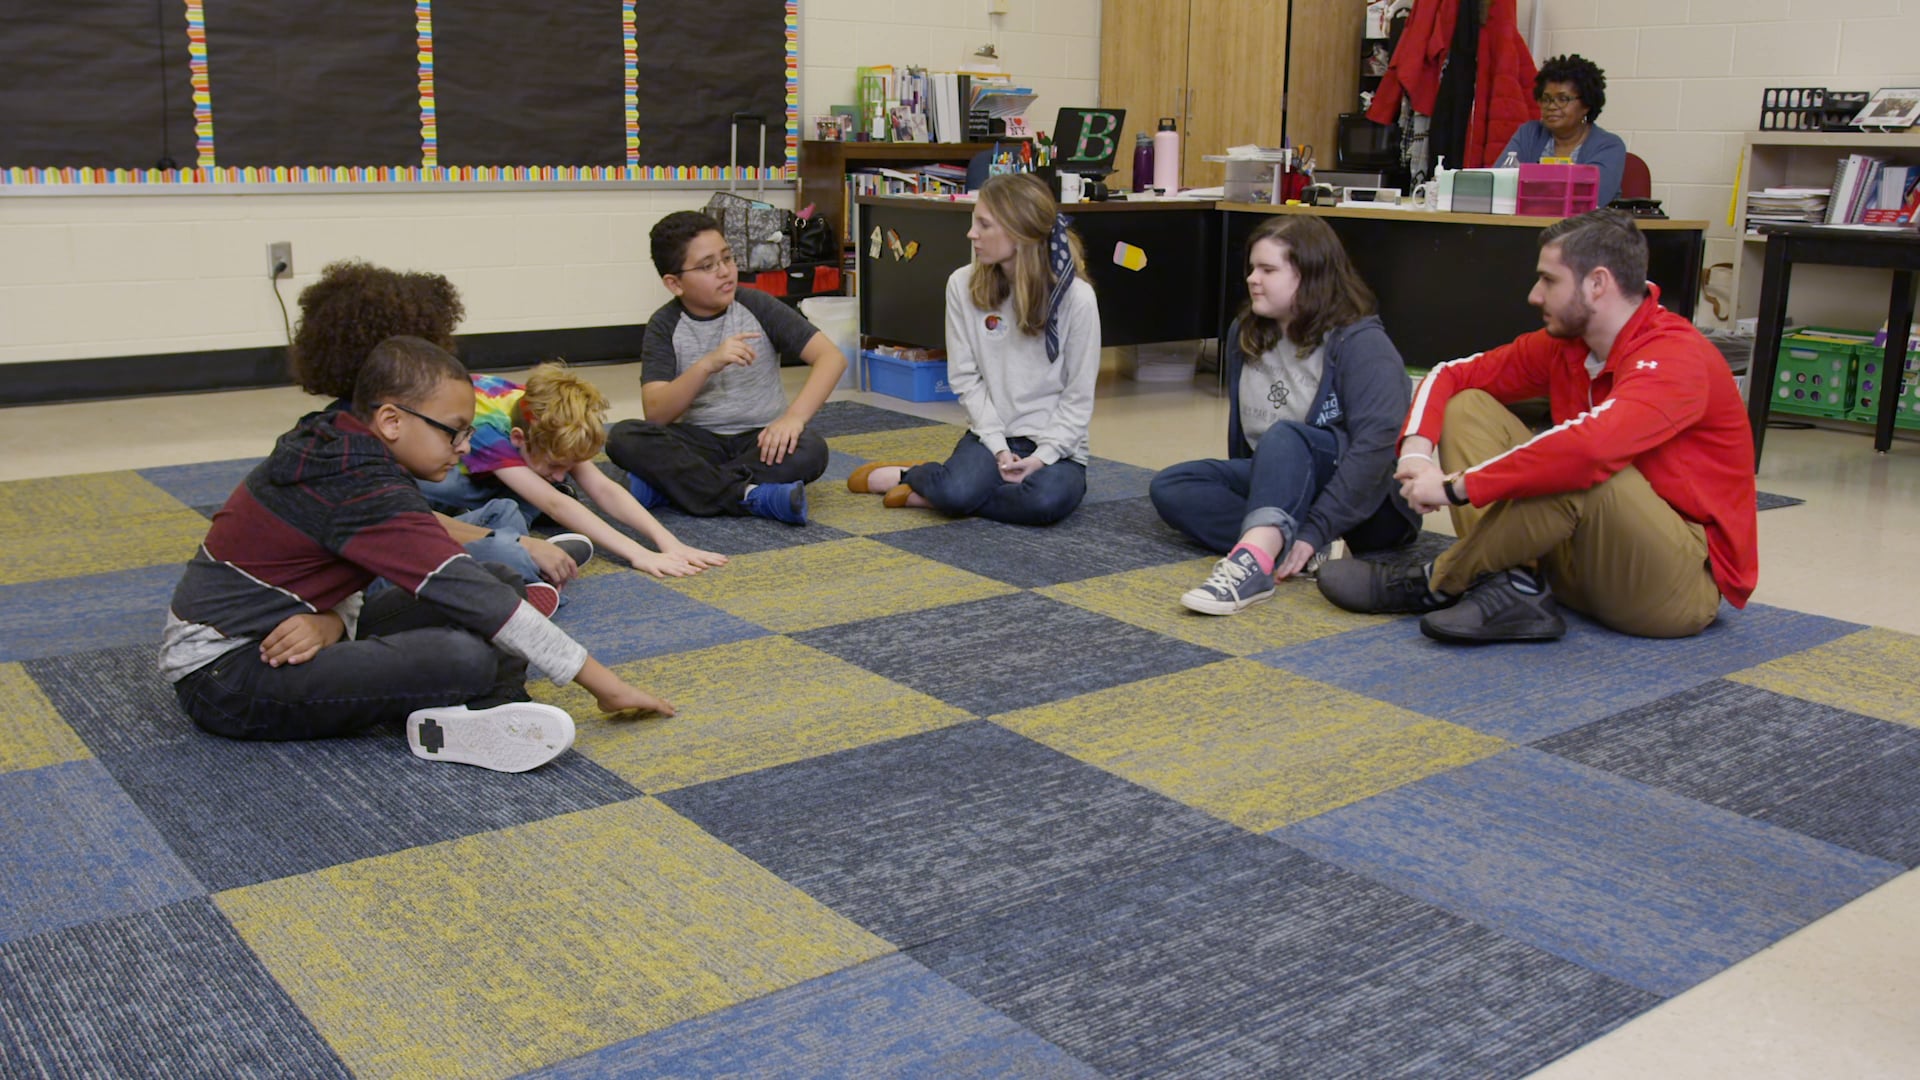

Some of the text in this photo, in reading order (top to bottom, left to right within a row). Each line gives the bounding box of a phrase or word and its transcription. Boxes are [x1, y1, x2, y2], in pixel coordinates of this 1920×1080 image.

[1008, 117, 1015, 127] I
[1010, 126, 1026, 136] NY
[1067, 111, 1118, 162] B
